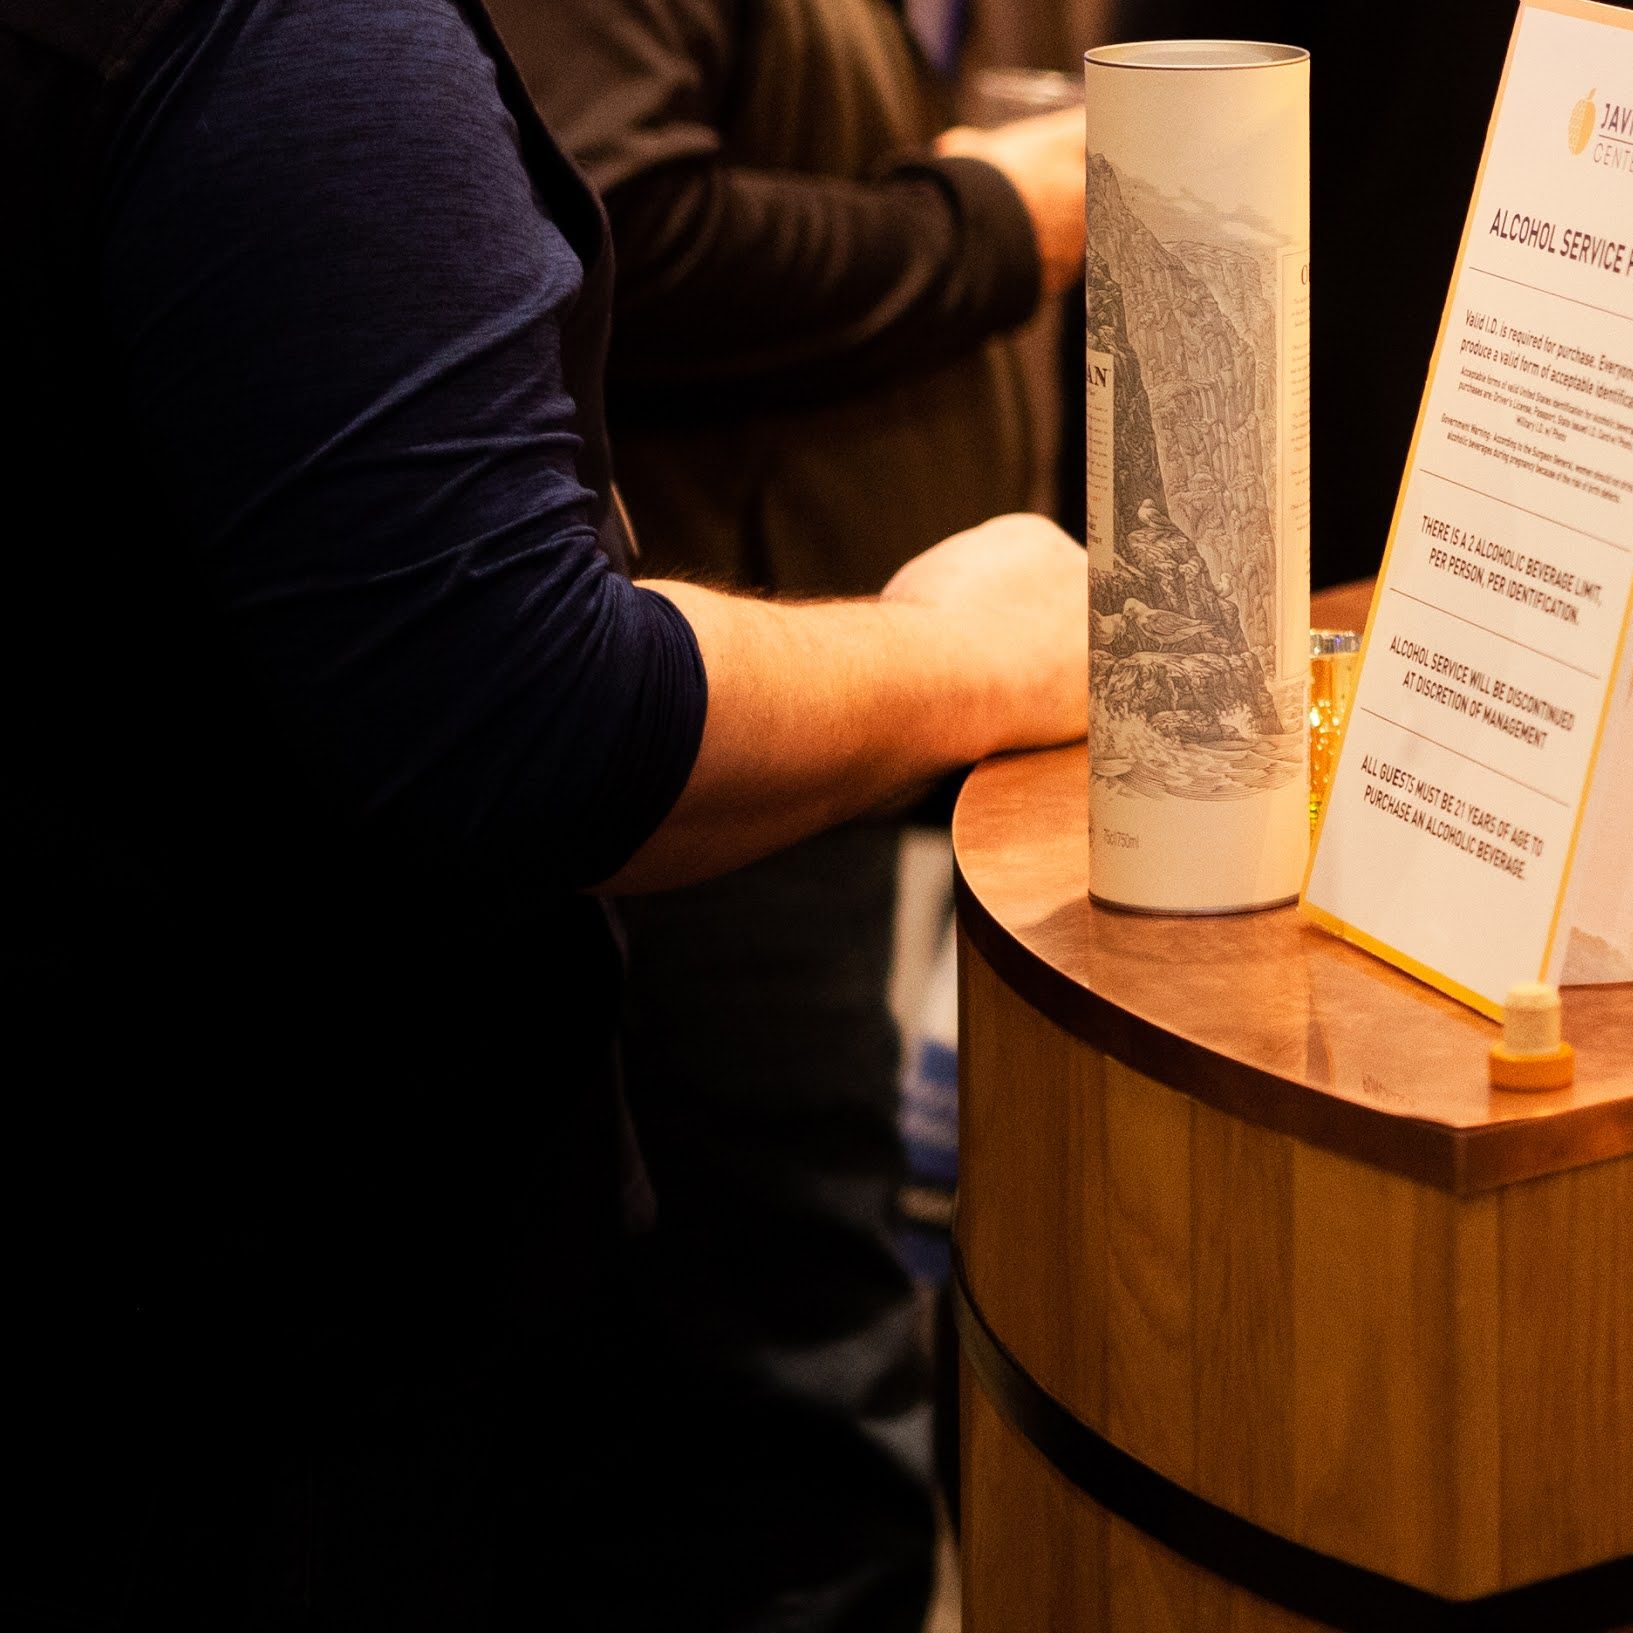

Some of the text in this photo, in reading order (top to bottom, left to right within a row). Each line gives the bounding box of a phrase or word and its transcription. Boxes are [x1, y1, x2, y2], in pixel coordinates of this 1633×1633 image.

[1489, 208, 1556, 254] ALCOHOL
[1560, 229, 1626, 273] SERVICE
[1460, 339, 1492, 360] produce
[1492, 350, 1499, 362] a
[1500, 351, 1520, 369] valid
[1519, 355, 1540, 376] form
[1541, 363, 1552, 379] of
[1550, 369, 1594, 395] acceptable
[1466, 309, 1485, 330] Valid
[1485, 316, 1498, 335] I.D.
[1500, 320, 1508, 338] is
[1508, 327, 1544, 350] required
[1544, 336, 1557, 353] for
[1556, 344, 1596, 369] purchase.
[1421, 515, 1450, 542] THERE
[1450, 527, 1461, 546] IS
[1460, 532, 1467, 549] A
[1467, 534, 1475, 552] 2
[1474, 537, 1526, 572] ALCOHOLIC
[1525, 558, 1575, 593] BEVERAGE
[1429, 547, 1579, 625] PER PERSON, PER IDENTIFICATION.
[1389, 635, 1575, 732] ALCOHOL SERVICE WILL BE DISCONTINUED
[1402, 670, 1548, 750] AT DISCRETION OF MANAGEMENT
[1361, 754, 1544, 858] ALL GUESTS MUST BE 21 YEARS OF AGE TO
[1363, 784, 1526, 881] PURCHASE AN ALCOHOLIC BEVERAGE.
